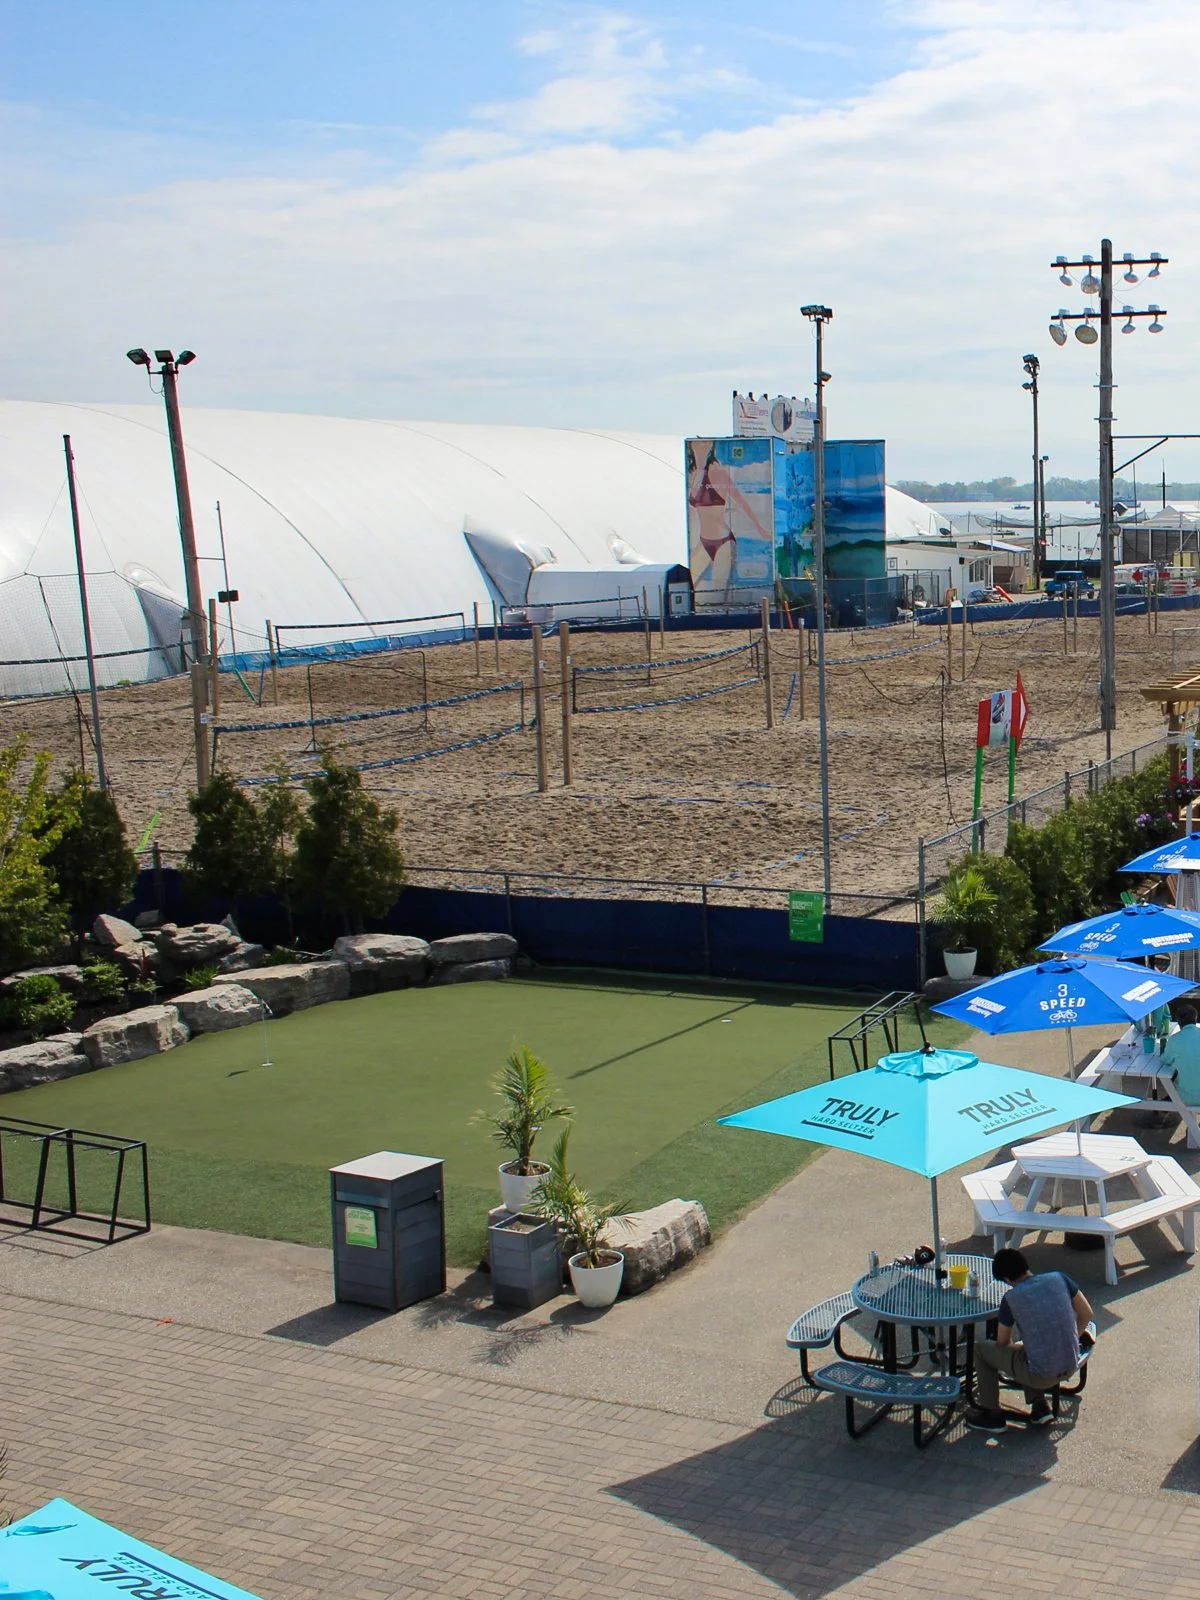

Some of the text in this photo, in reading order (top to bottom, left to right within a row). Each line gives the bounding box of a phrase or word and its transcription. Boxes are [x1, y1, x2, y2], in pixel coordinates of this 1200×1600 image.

[1084, 932, 1118, 943] SPEED
[1105, 922, 1120, 933] 3
[1057, 983, 1068, 997] 3
[1039, 997, 1087, 1011] SPEED
[819, 1097, 900, 1127] TRULY
[957, 1087, 1042, 1122] TRULY
[811, 1115, 875, 1135] HARD SELTZER
[982, 1104, 1048, 1130] HARD SELTZER
[58, 1557, 183, 1600] RULY
[113, 1555, 214, 1600] ARD SELTZER
